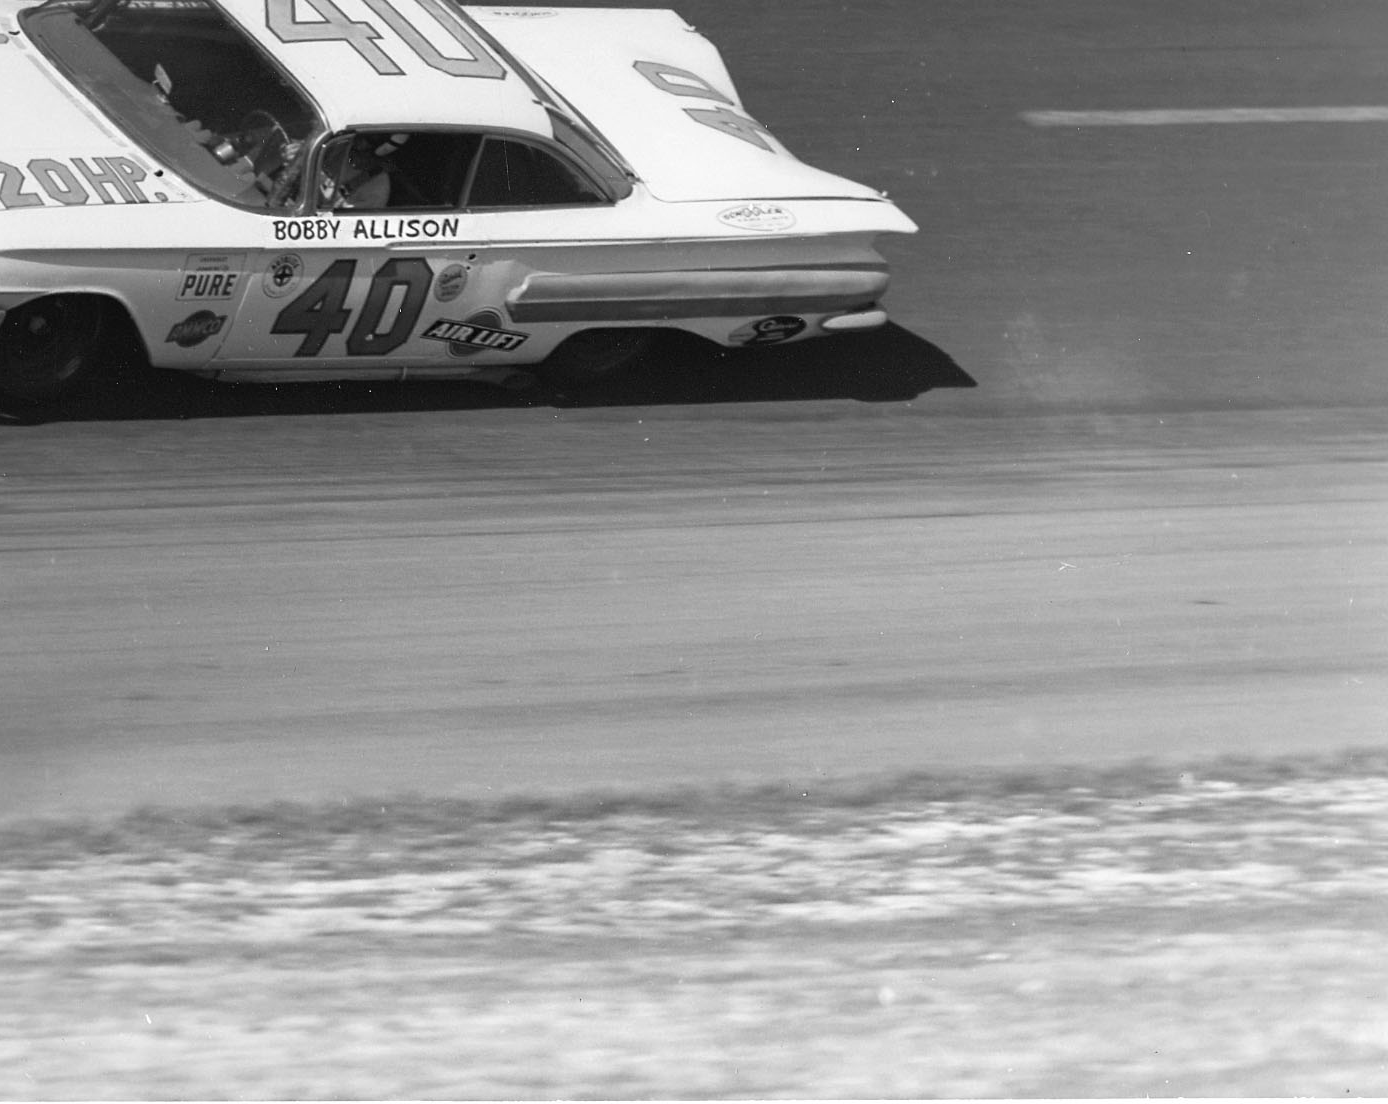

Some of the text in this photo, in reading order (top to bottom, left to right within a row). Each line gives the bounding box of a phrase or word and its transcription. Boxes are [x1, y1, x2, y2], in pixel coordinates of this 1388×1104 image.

[272, 218, 460, 240] BOBBY ALLISON
[180, 273, 237, 297] PURE
[269, 256, 435, 358] 40
[427, 322, 525, 350] AIR LIFT
